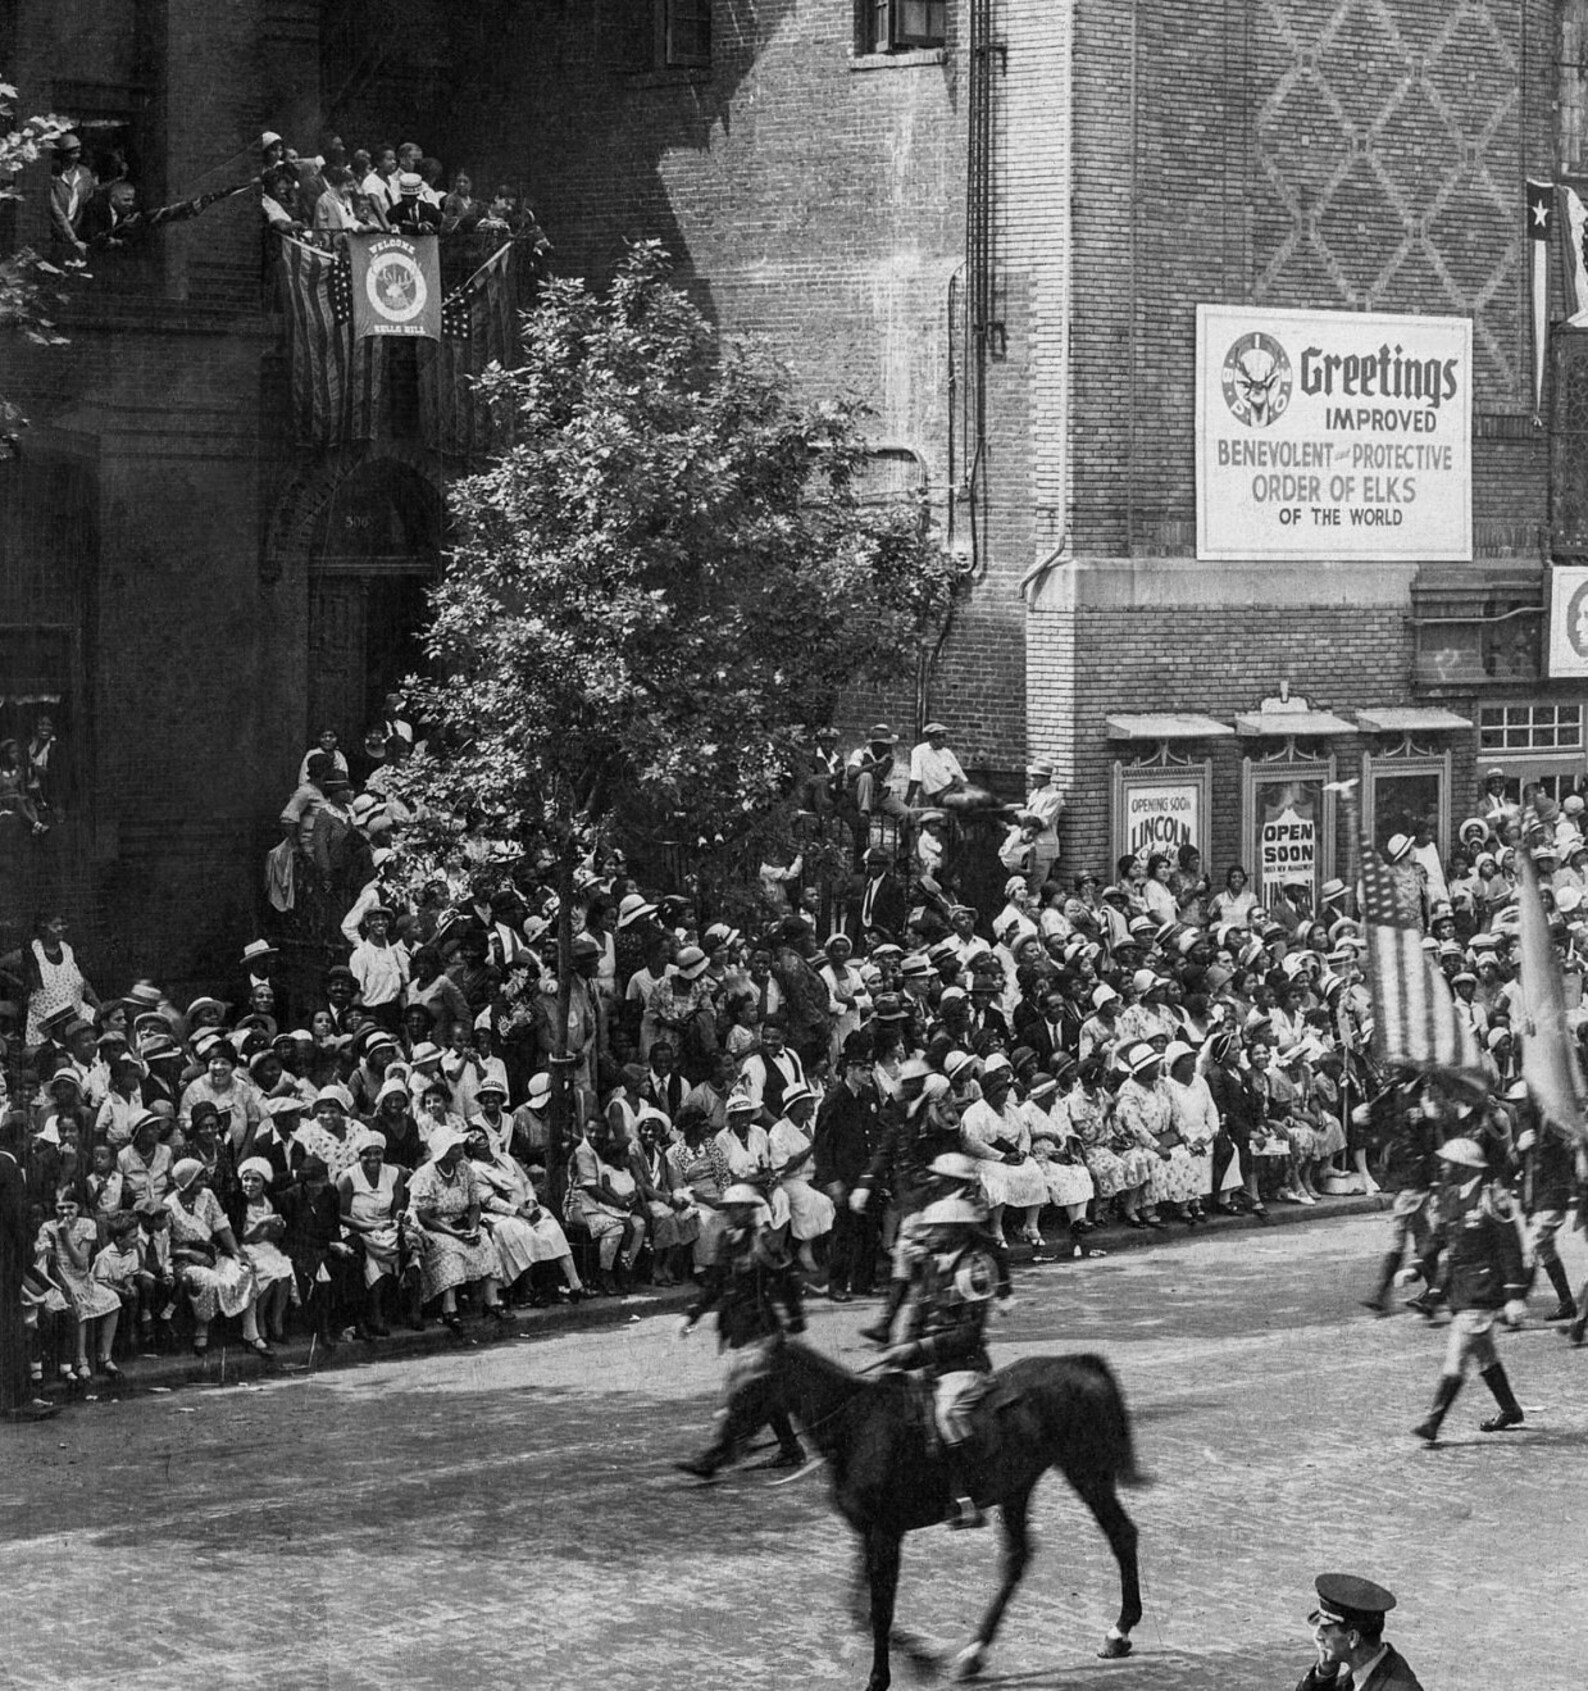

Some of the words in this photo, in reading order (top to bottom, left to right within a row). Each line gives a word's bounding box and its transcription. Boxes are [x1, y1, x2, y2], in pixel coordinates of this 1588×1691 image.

[368, 239, 416, 255] WELCOME
[1300, 343, 1459, 409] Greetings
[1325, 407, 1437, 433] IMPROVED
[1218, 439, 1334, 468] BENEVOLENT
[1352, 443, 1452, 470] PROTECTIVE
[1252, 474, 1321, 502] ORDER
[1330, 475, 1355, 502] OF
[1363, 476, 1416, 503] ELKS
[1279, 508, 1301, 526] OF
[1311, 507, 1341, 526] THE
[1350, 508, 1403, 526] WORLD
[1131, 797, 1168, 813] OPENING
[1132, 815, 1191, 855] LINCOLN
[1264, 823, 1313, 842] OPEN
[1264, 844, 1314, 863] SOON
